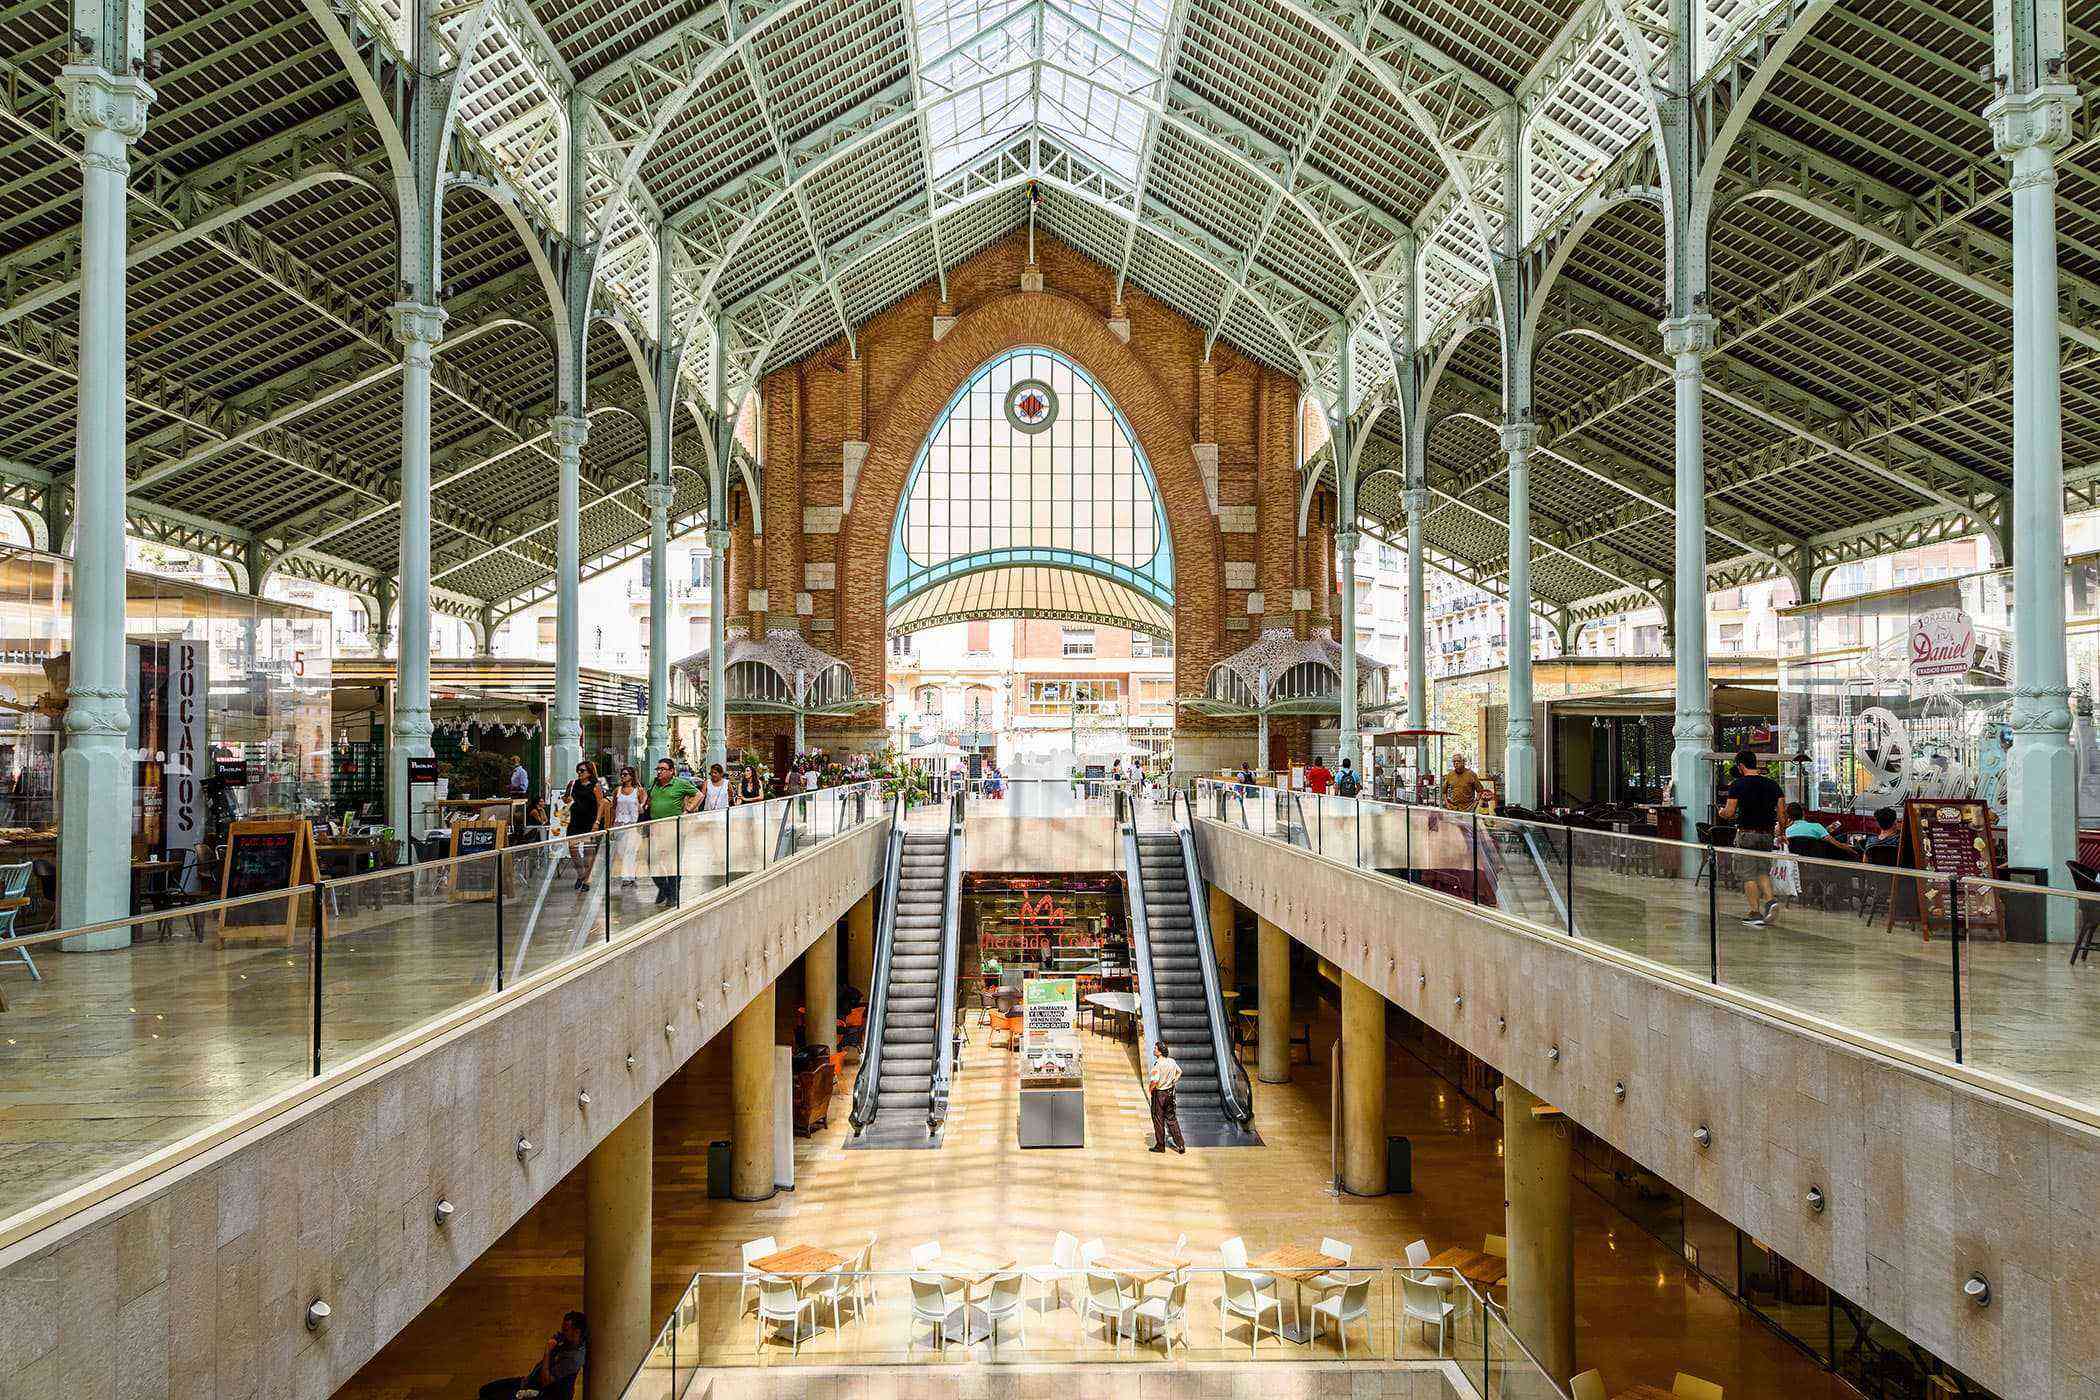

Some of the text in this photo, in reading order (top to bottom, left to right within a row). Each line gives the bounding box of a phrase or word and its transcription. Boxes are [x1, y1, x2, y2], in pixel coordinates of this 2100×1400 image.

[1911, 631, 1971, 665] Daniel
[178, 645, 194, 831] BOCADOS
[981, 932, 1050, 949] Mercado
